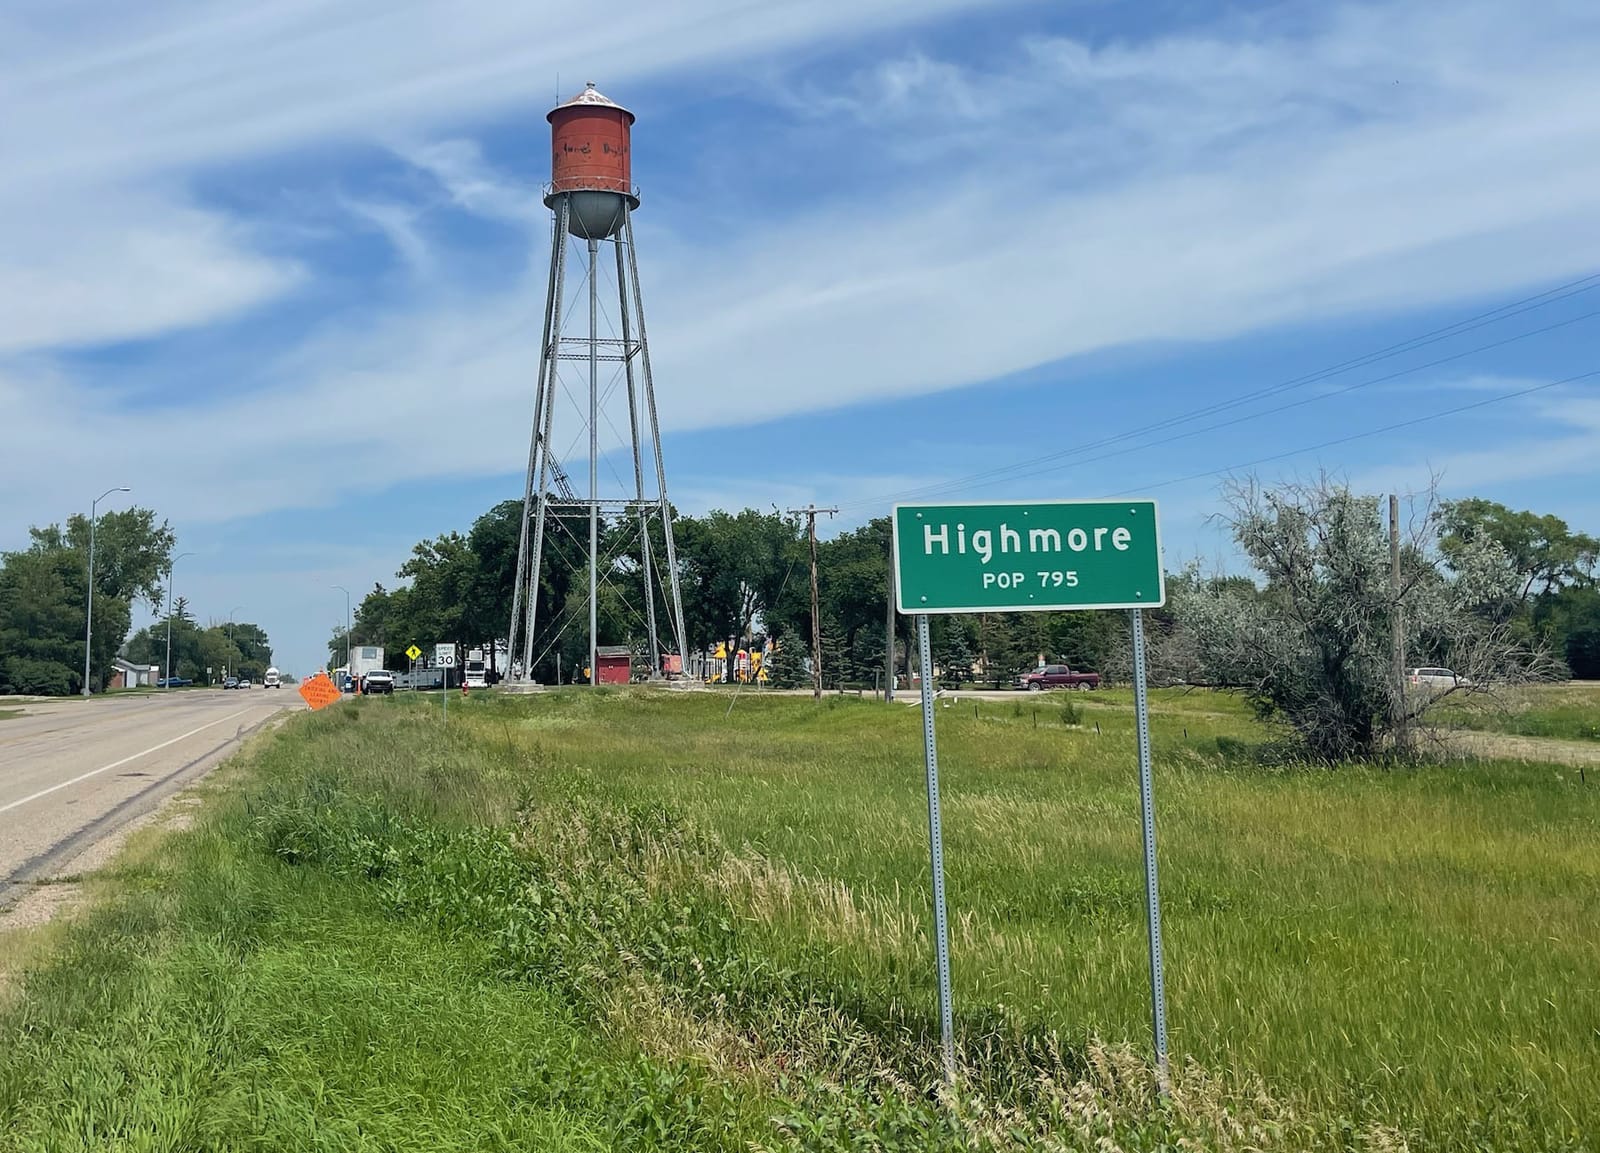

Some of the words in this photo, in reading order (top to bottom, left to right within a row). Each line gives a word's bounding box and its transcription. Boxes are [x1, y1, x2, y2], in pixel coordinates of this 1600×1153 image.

[924, 523, 1132, 564] Highmore
[983, 572, 1025, 589] POP
[1037, 571, 1079, 587] 795
[438, 656, 453, 665] 30
